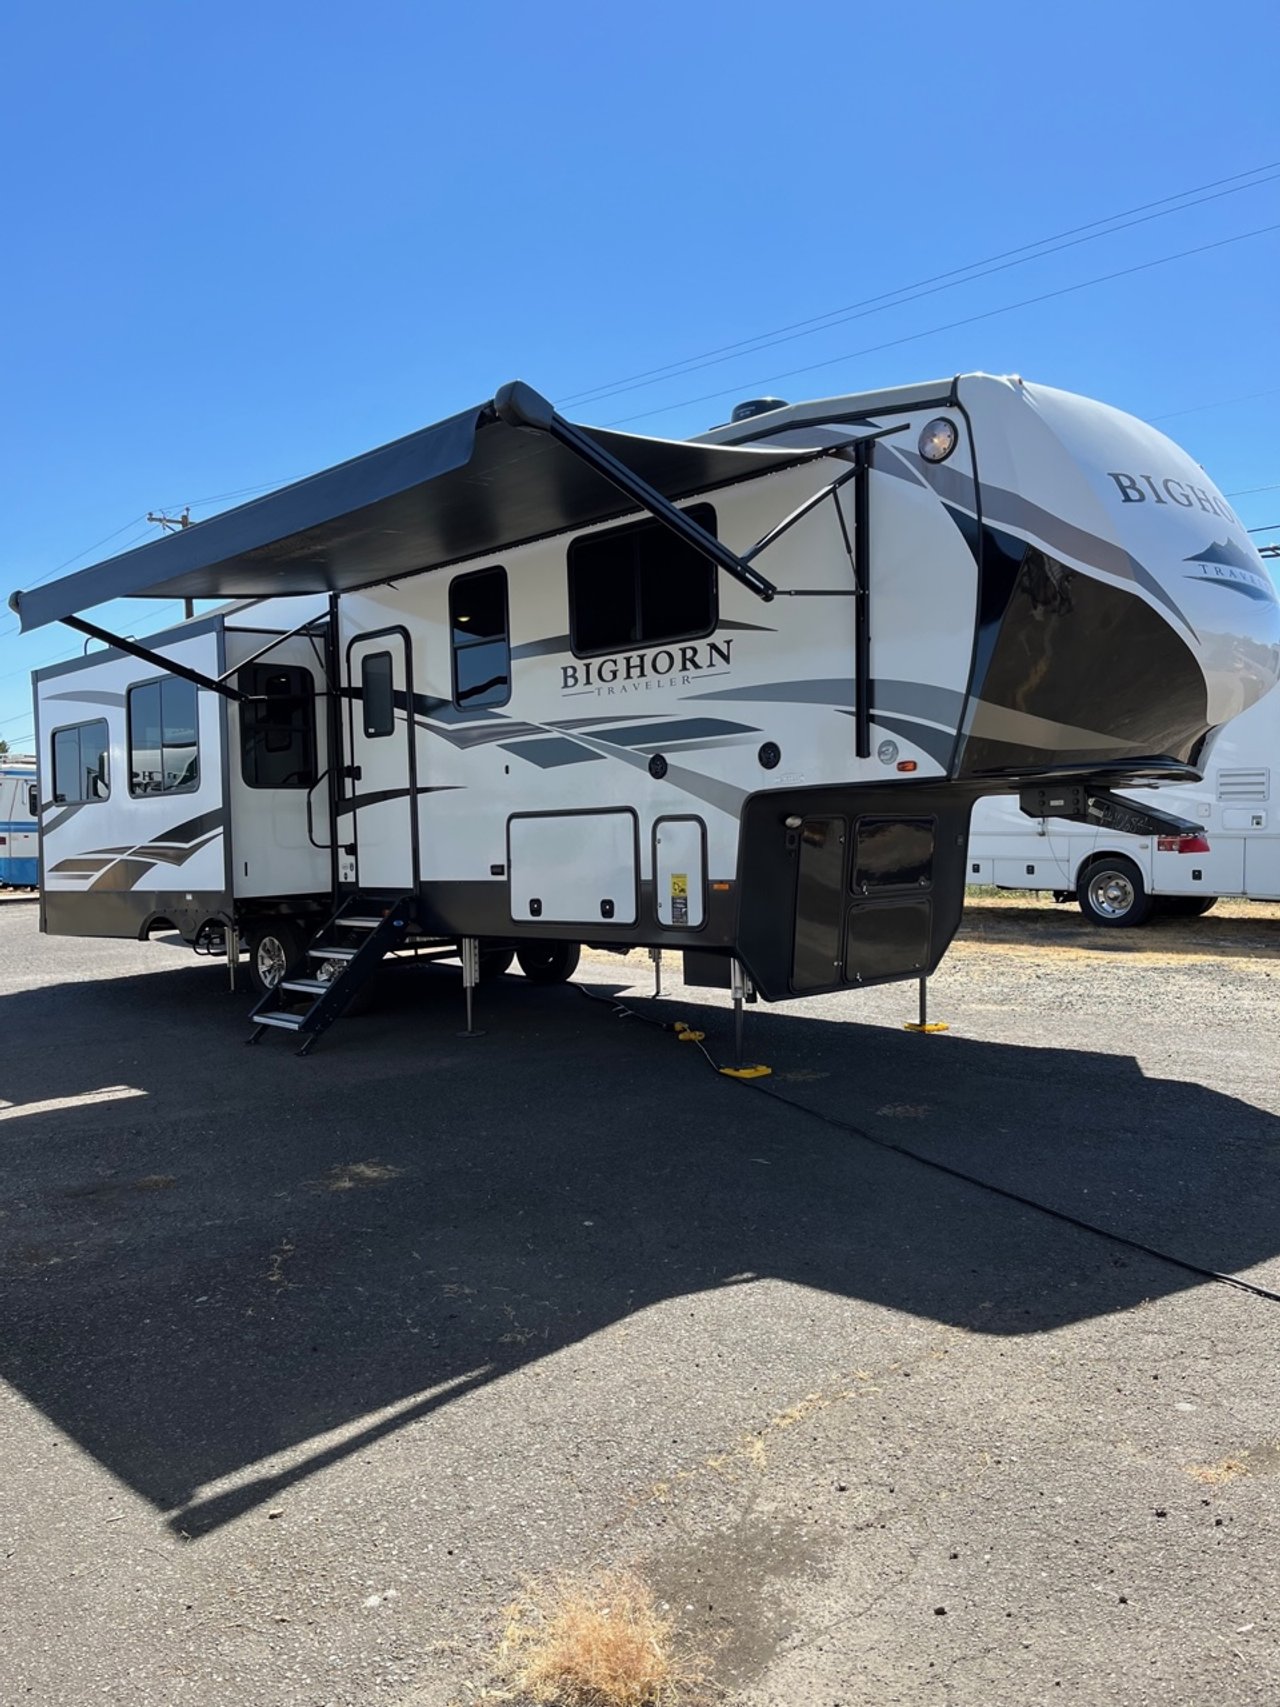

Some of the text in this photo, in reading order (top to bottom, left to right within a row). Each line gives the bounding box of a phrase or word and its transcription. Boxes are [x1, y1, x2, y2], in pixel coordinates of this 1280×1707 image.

[1107, 472, 1237, 524] BIGHO
[560, 639, 733, 689] BIGHORN
[595, 675, 691, 696] TRAVELER
